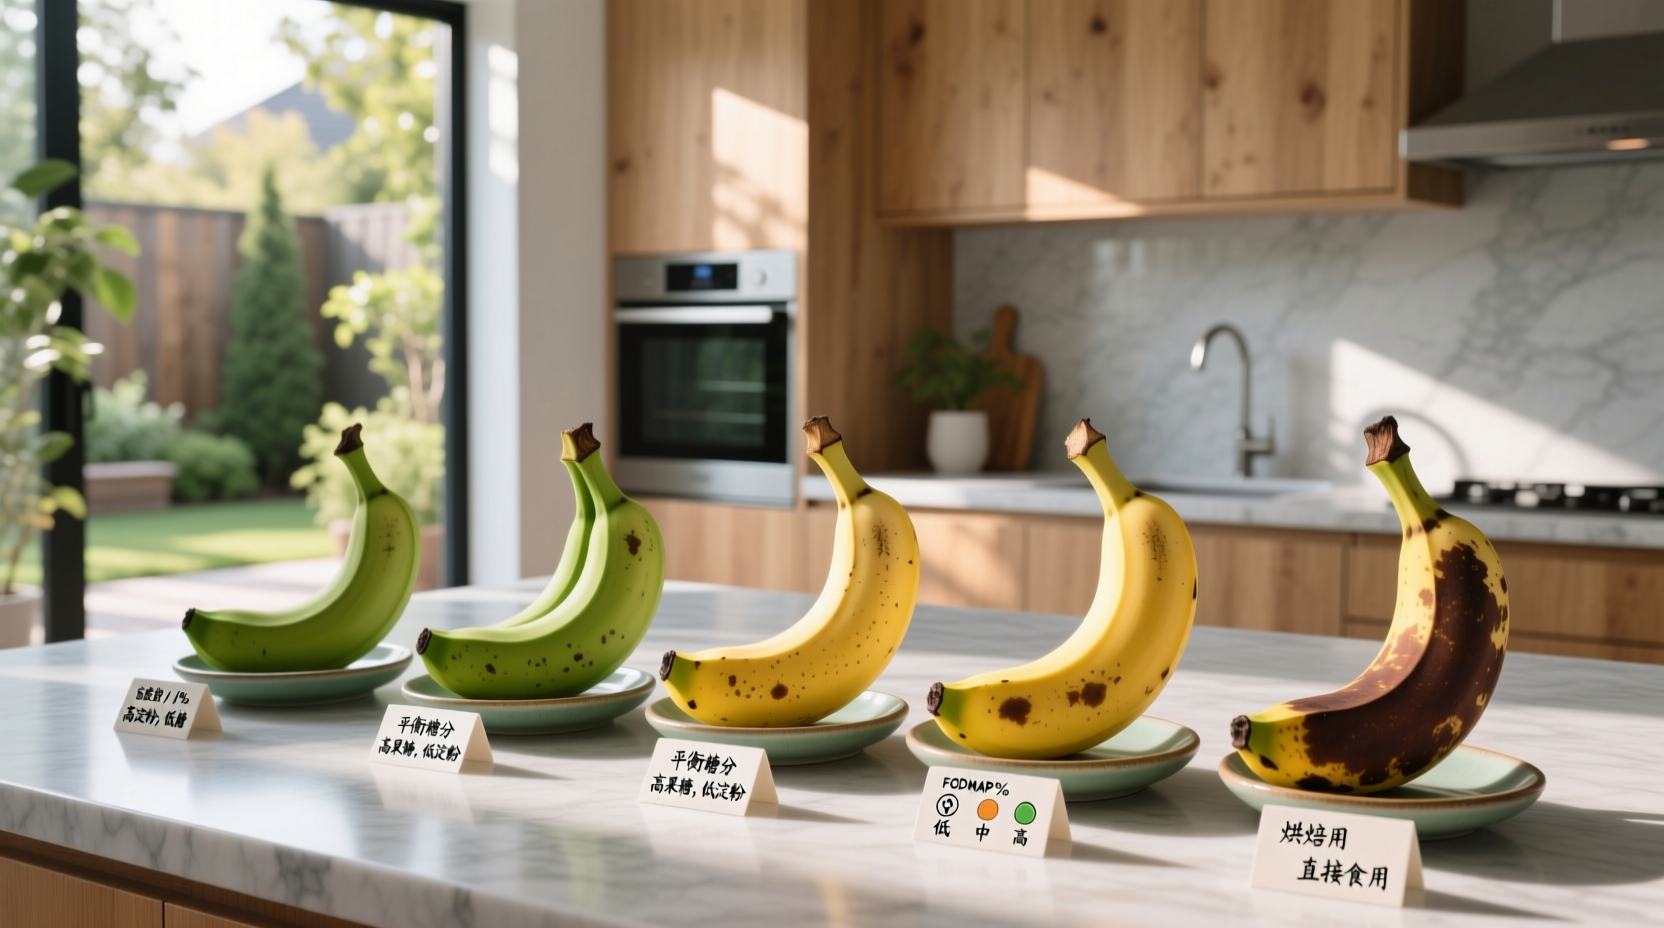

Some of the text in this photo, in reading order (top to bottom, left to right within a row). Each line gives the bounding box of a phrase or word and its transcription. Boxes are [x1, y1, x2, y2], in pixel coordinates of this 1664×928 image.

[933, 819, 1028, 847] 低 中 高
[1279, 820, 1348, 851] 烘焙用
[1296, 856, 1388, 891] 直接食用
